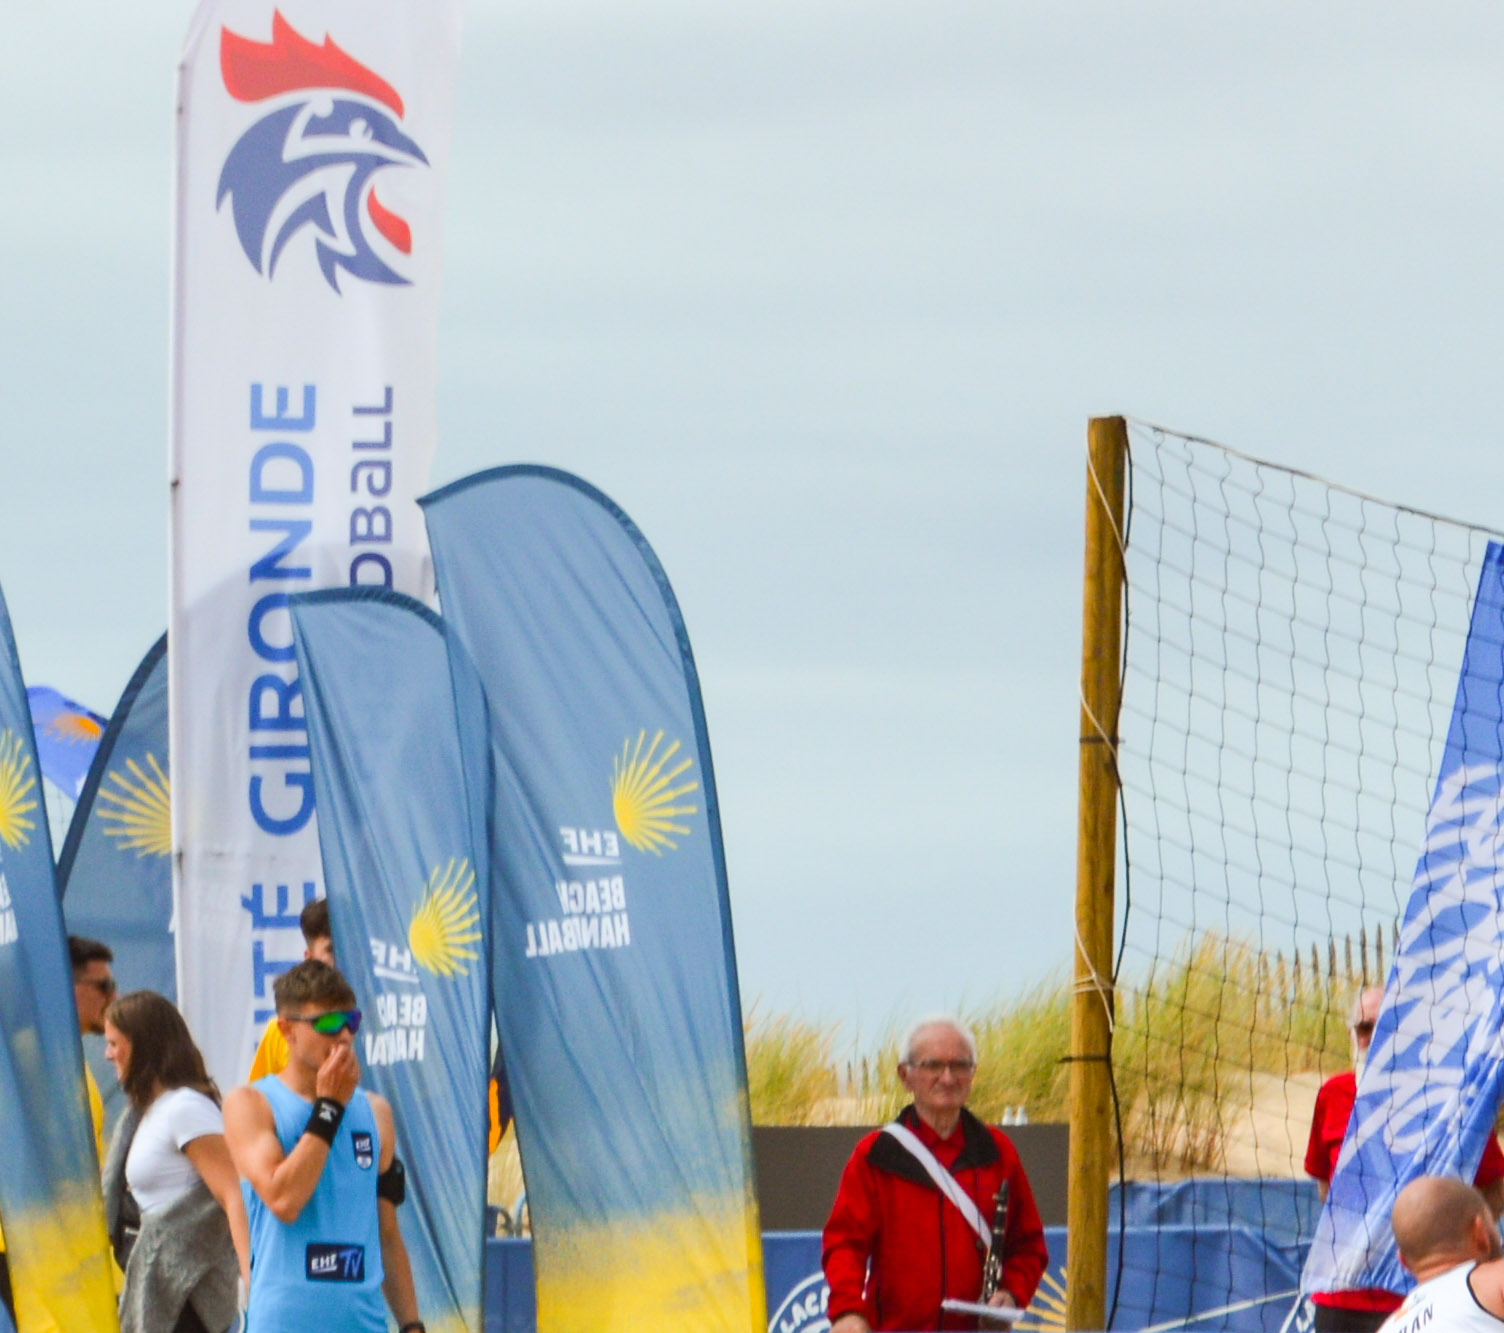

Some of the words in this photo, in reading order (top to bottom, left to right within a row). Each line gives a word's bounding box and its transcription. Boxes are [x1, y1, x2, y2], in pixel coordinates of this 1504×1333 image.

[247, 383, 317, 837] GIRONDE
[311, 1254, 338, 1273] EHF
[339, 1249, 363, 1279] TV
